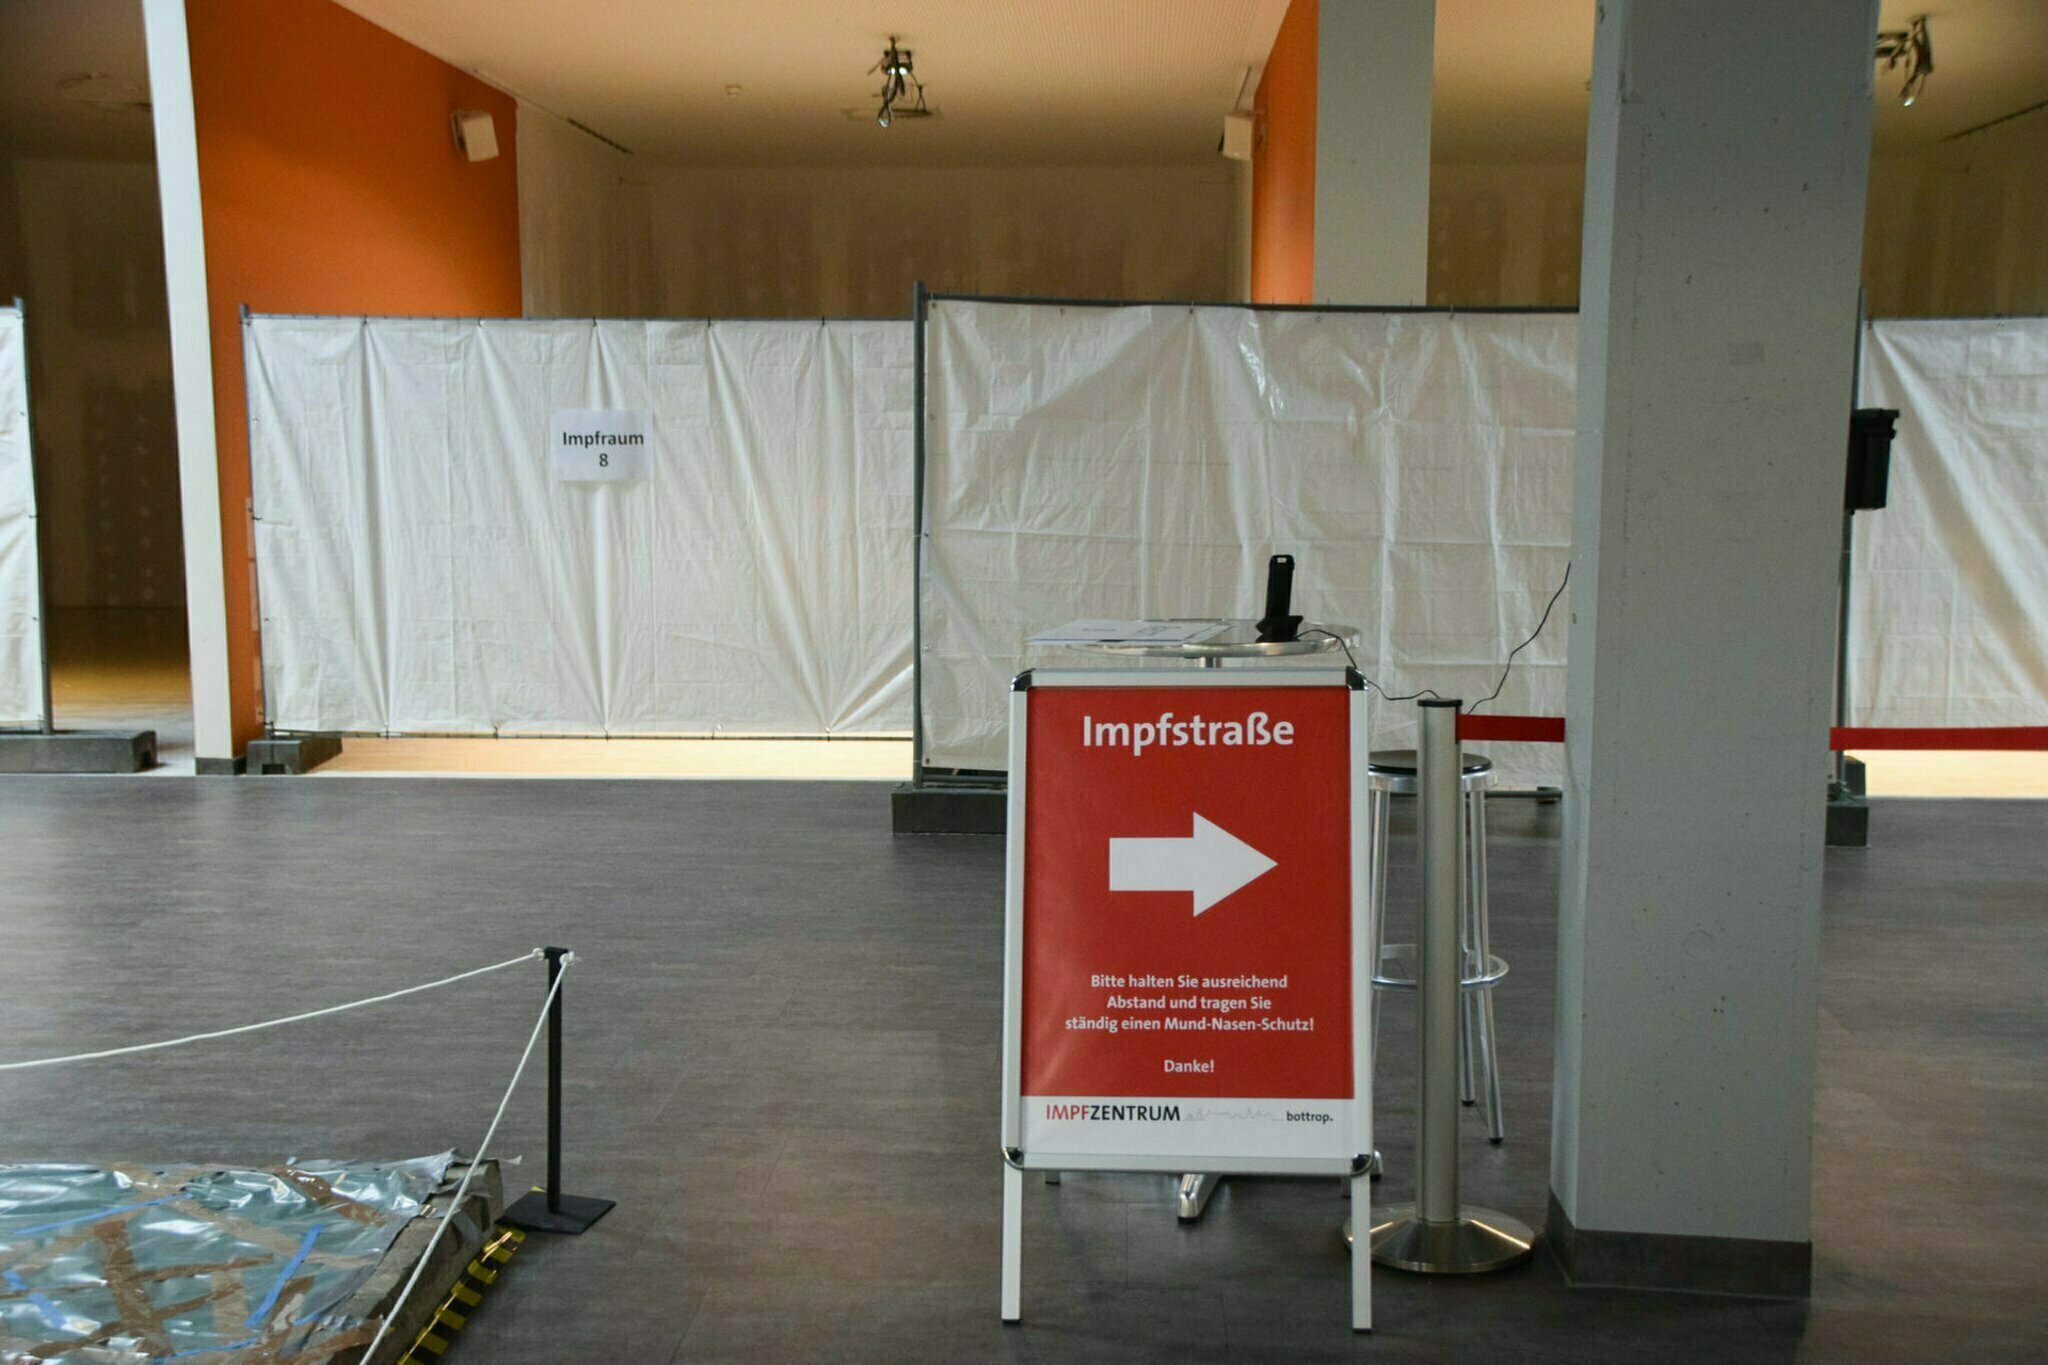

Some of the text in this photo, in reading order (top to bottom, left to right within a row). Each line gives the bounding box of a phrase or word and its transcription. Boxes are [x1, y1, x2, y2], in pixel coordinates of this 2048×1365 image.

[563, 431, 644, 448] Impfraum
[599, 453, 609, 467] 8
[1083, 712, 1294, 756] Impfstraße
[1091, 975, 1288, 988] Bitte halten Sie ausreichend
[1107, 996, 1272, 1013] Abstand und tragen Sie
[1065, 1017, 1314, 1033] ständig einen Mund-Nasen-Schutz!
[1164, 1059, 1214, 1073] Danke!
[1046, 1104, 1180, 1121] IMPFZENTRUM
[1286, 1111, 1333, 1125] bottrop.
